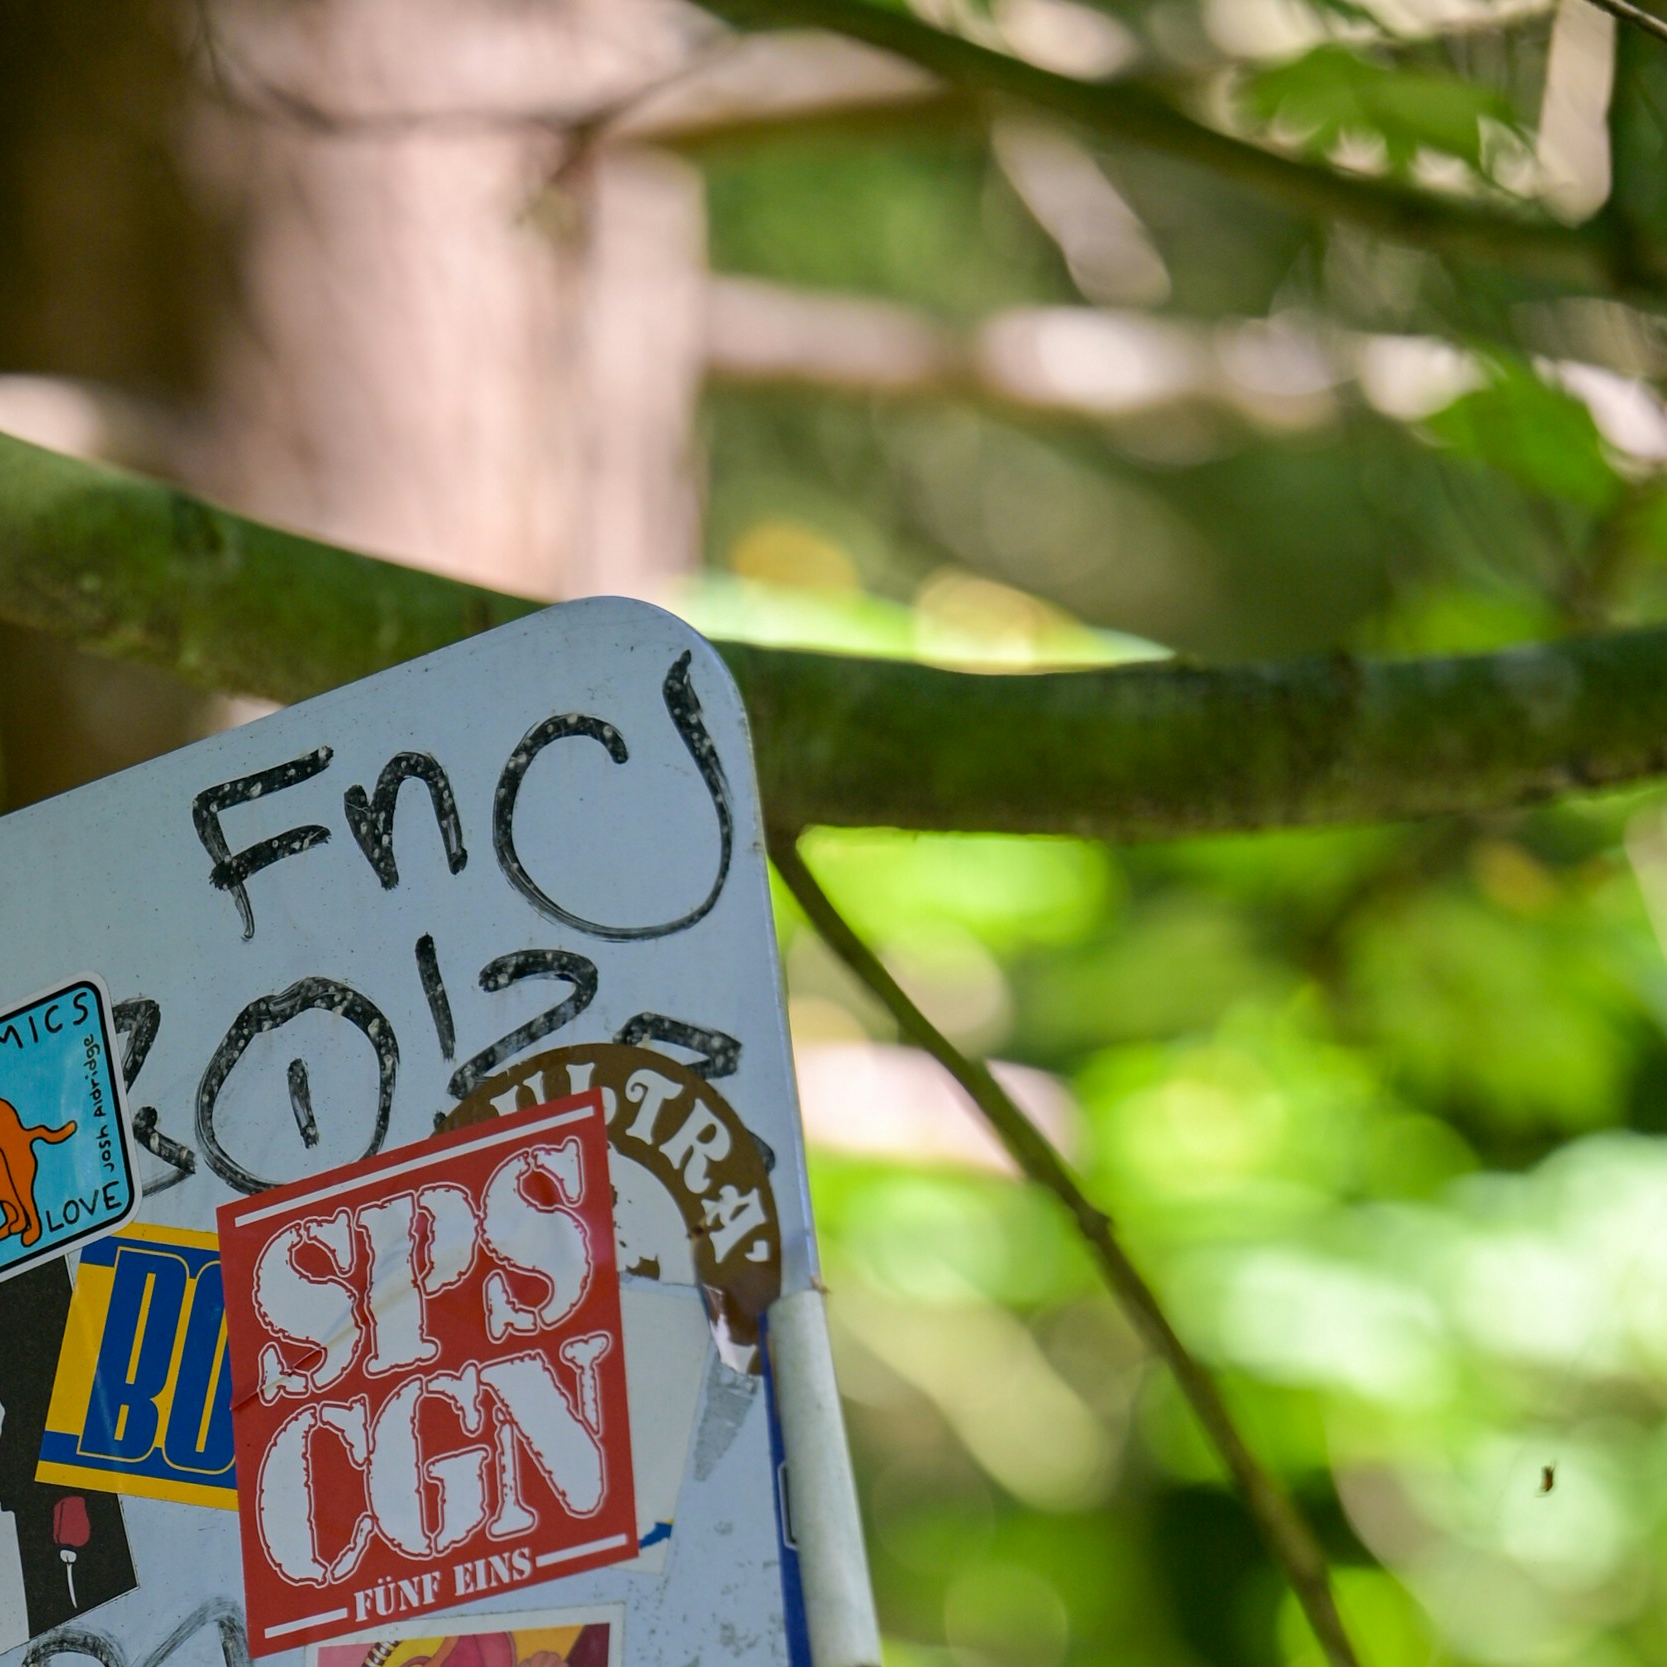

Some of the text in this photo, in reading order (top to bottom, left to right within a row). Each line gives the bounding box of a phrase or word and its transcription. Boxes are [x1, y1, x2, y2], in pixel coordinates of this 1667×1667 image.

[45, 1180, 123, 1233] LOVE
[254, 1136, 594, 1405] SPS
[256, 1331, 611, 1586] CGN
[353, 1546, 535, 1624] FÜNF EINS
